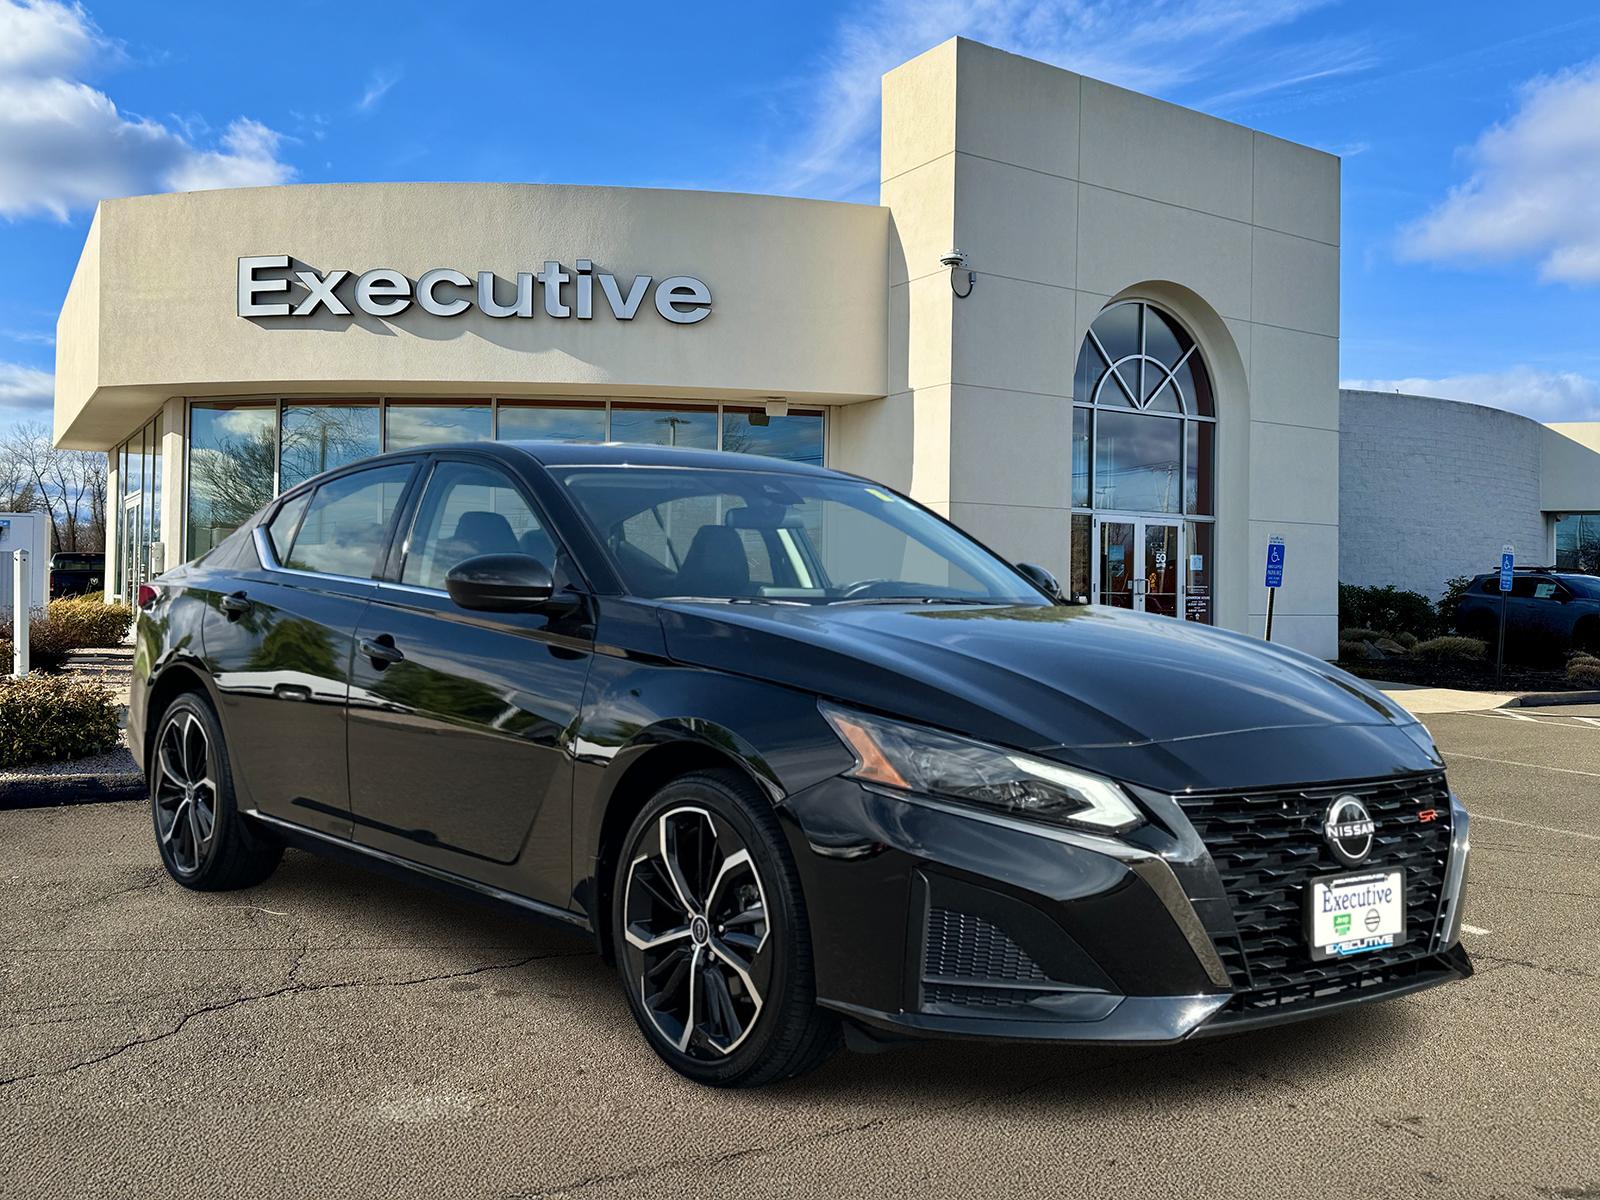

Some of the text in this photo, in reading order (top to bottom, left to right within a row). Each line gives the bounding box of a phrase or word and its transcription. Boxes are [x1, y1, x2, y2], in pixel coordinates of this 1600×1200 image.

[237, 254, 713, 325] Executive
[1155, 553, 1167, 563] 50
[1418, 809, 1438, 823] SR
[1327, 821, 1375, 838] NISSAN
[1322, 884, 1392, 913] Executive
